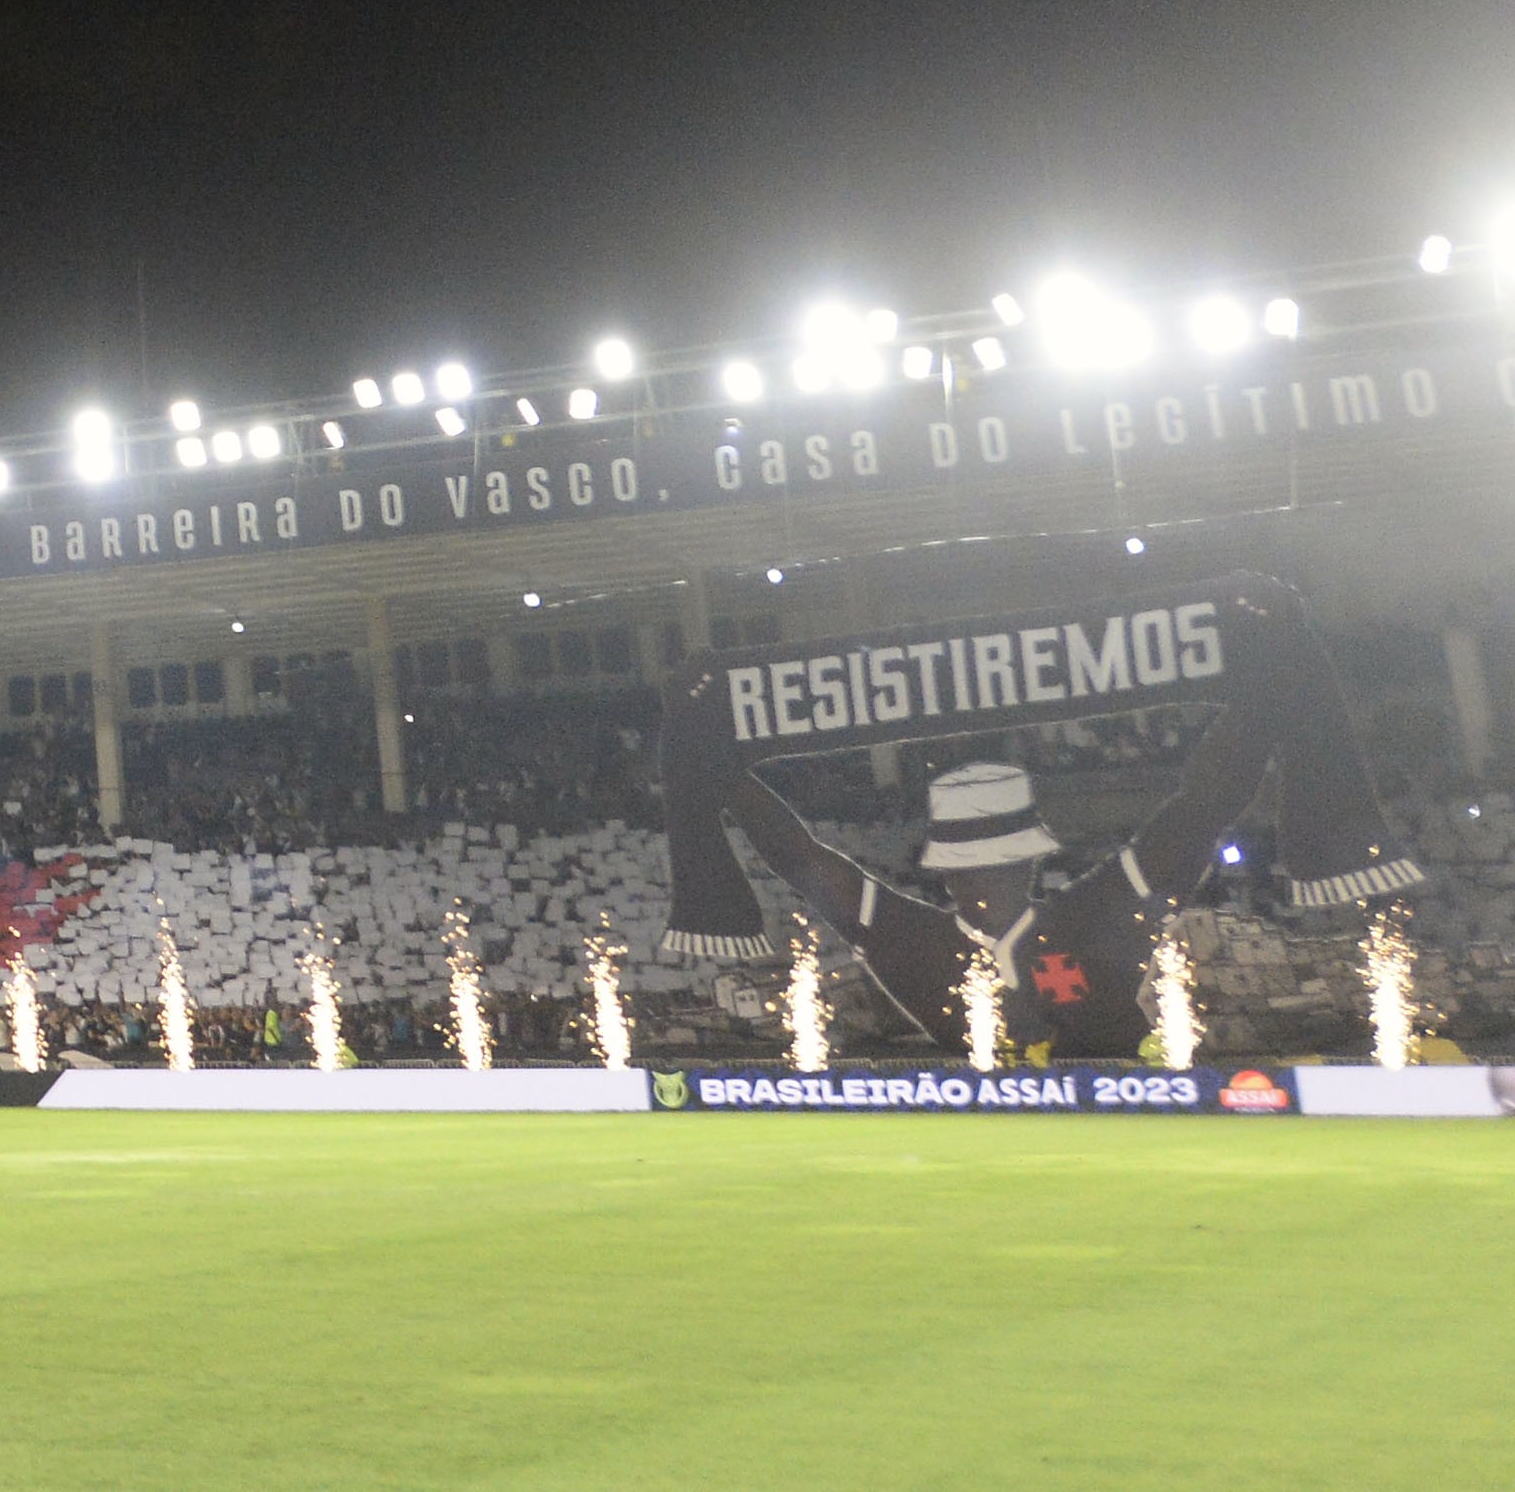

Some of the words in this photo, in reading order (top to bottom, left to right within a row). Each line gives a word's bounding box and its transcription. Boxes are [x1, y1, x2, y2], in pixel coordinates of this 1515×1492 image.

[339, 484, 404, 531] DO
[928, 416, 1008, 468] DO
[726, 602, 1223, 740] RESISTIREMOS
[699, 1072, 971, 1105] BRASILEIRÃO
[1092, 1076, 1199, 1104] 2023
